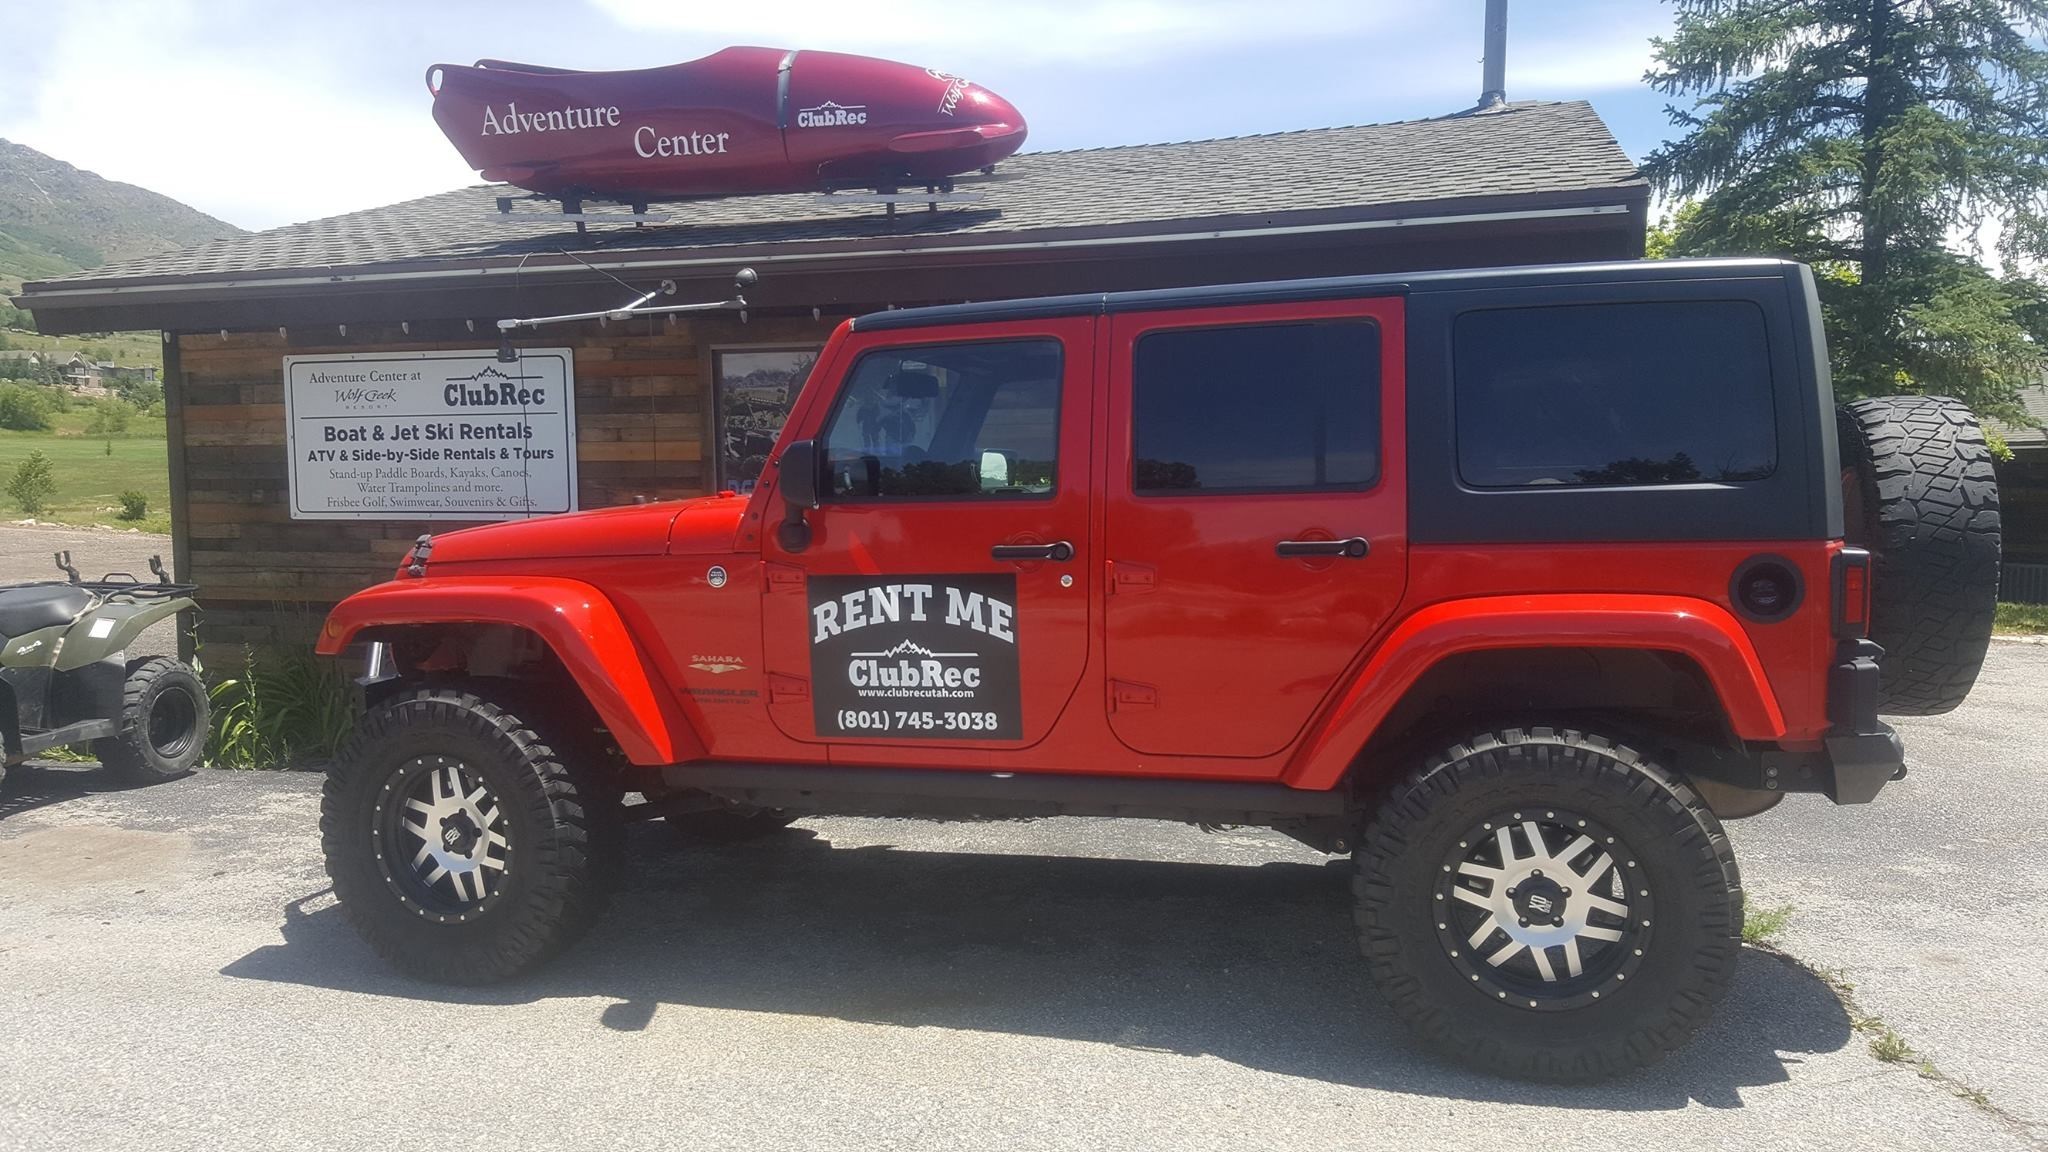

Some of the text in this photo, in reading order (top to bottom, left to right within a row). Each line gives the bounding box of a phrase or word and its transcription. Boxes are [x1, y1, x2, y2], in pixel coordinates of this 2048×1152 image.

[481, 102, 621, 136] Adventure
[797, 110, 867, 128] ClubRec
[634, 126, 729, 158] Center
[309, 370, 421, 384] Adventure Center at
[334, 388, 397, 404] Wolf Creek
[443, 382, 545, 407] ClubRec
[324, 422, 533, 442] Boat & Jet Ski Rentals
[308, 447, 555, 463] ATV & Side-by-Side Rentals & Tours
[329, 466, 532, 482] Stand-up Paddle Boards, Kayaks, Canoes,
[357, 482, 504, 496] Water Trampolines and more.
[327, 497, 361, 508] Frisbee
[362, 496, 388, 508] Golf,
[390, 496, 443, 508] Swimwear,
[444, 496, 495, 507] Souvenirs
[496, 496, 507, 507] &
[813, 584, 1014, 645] RENT ME
[691, 654, 744, 663] SAHARA
[848, 659, 981, 688] ClubRec
[858, 688, 975, 698] www.clubrecutah.com
[837, 709, 998, 731] (801) 745-3038
